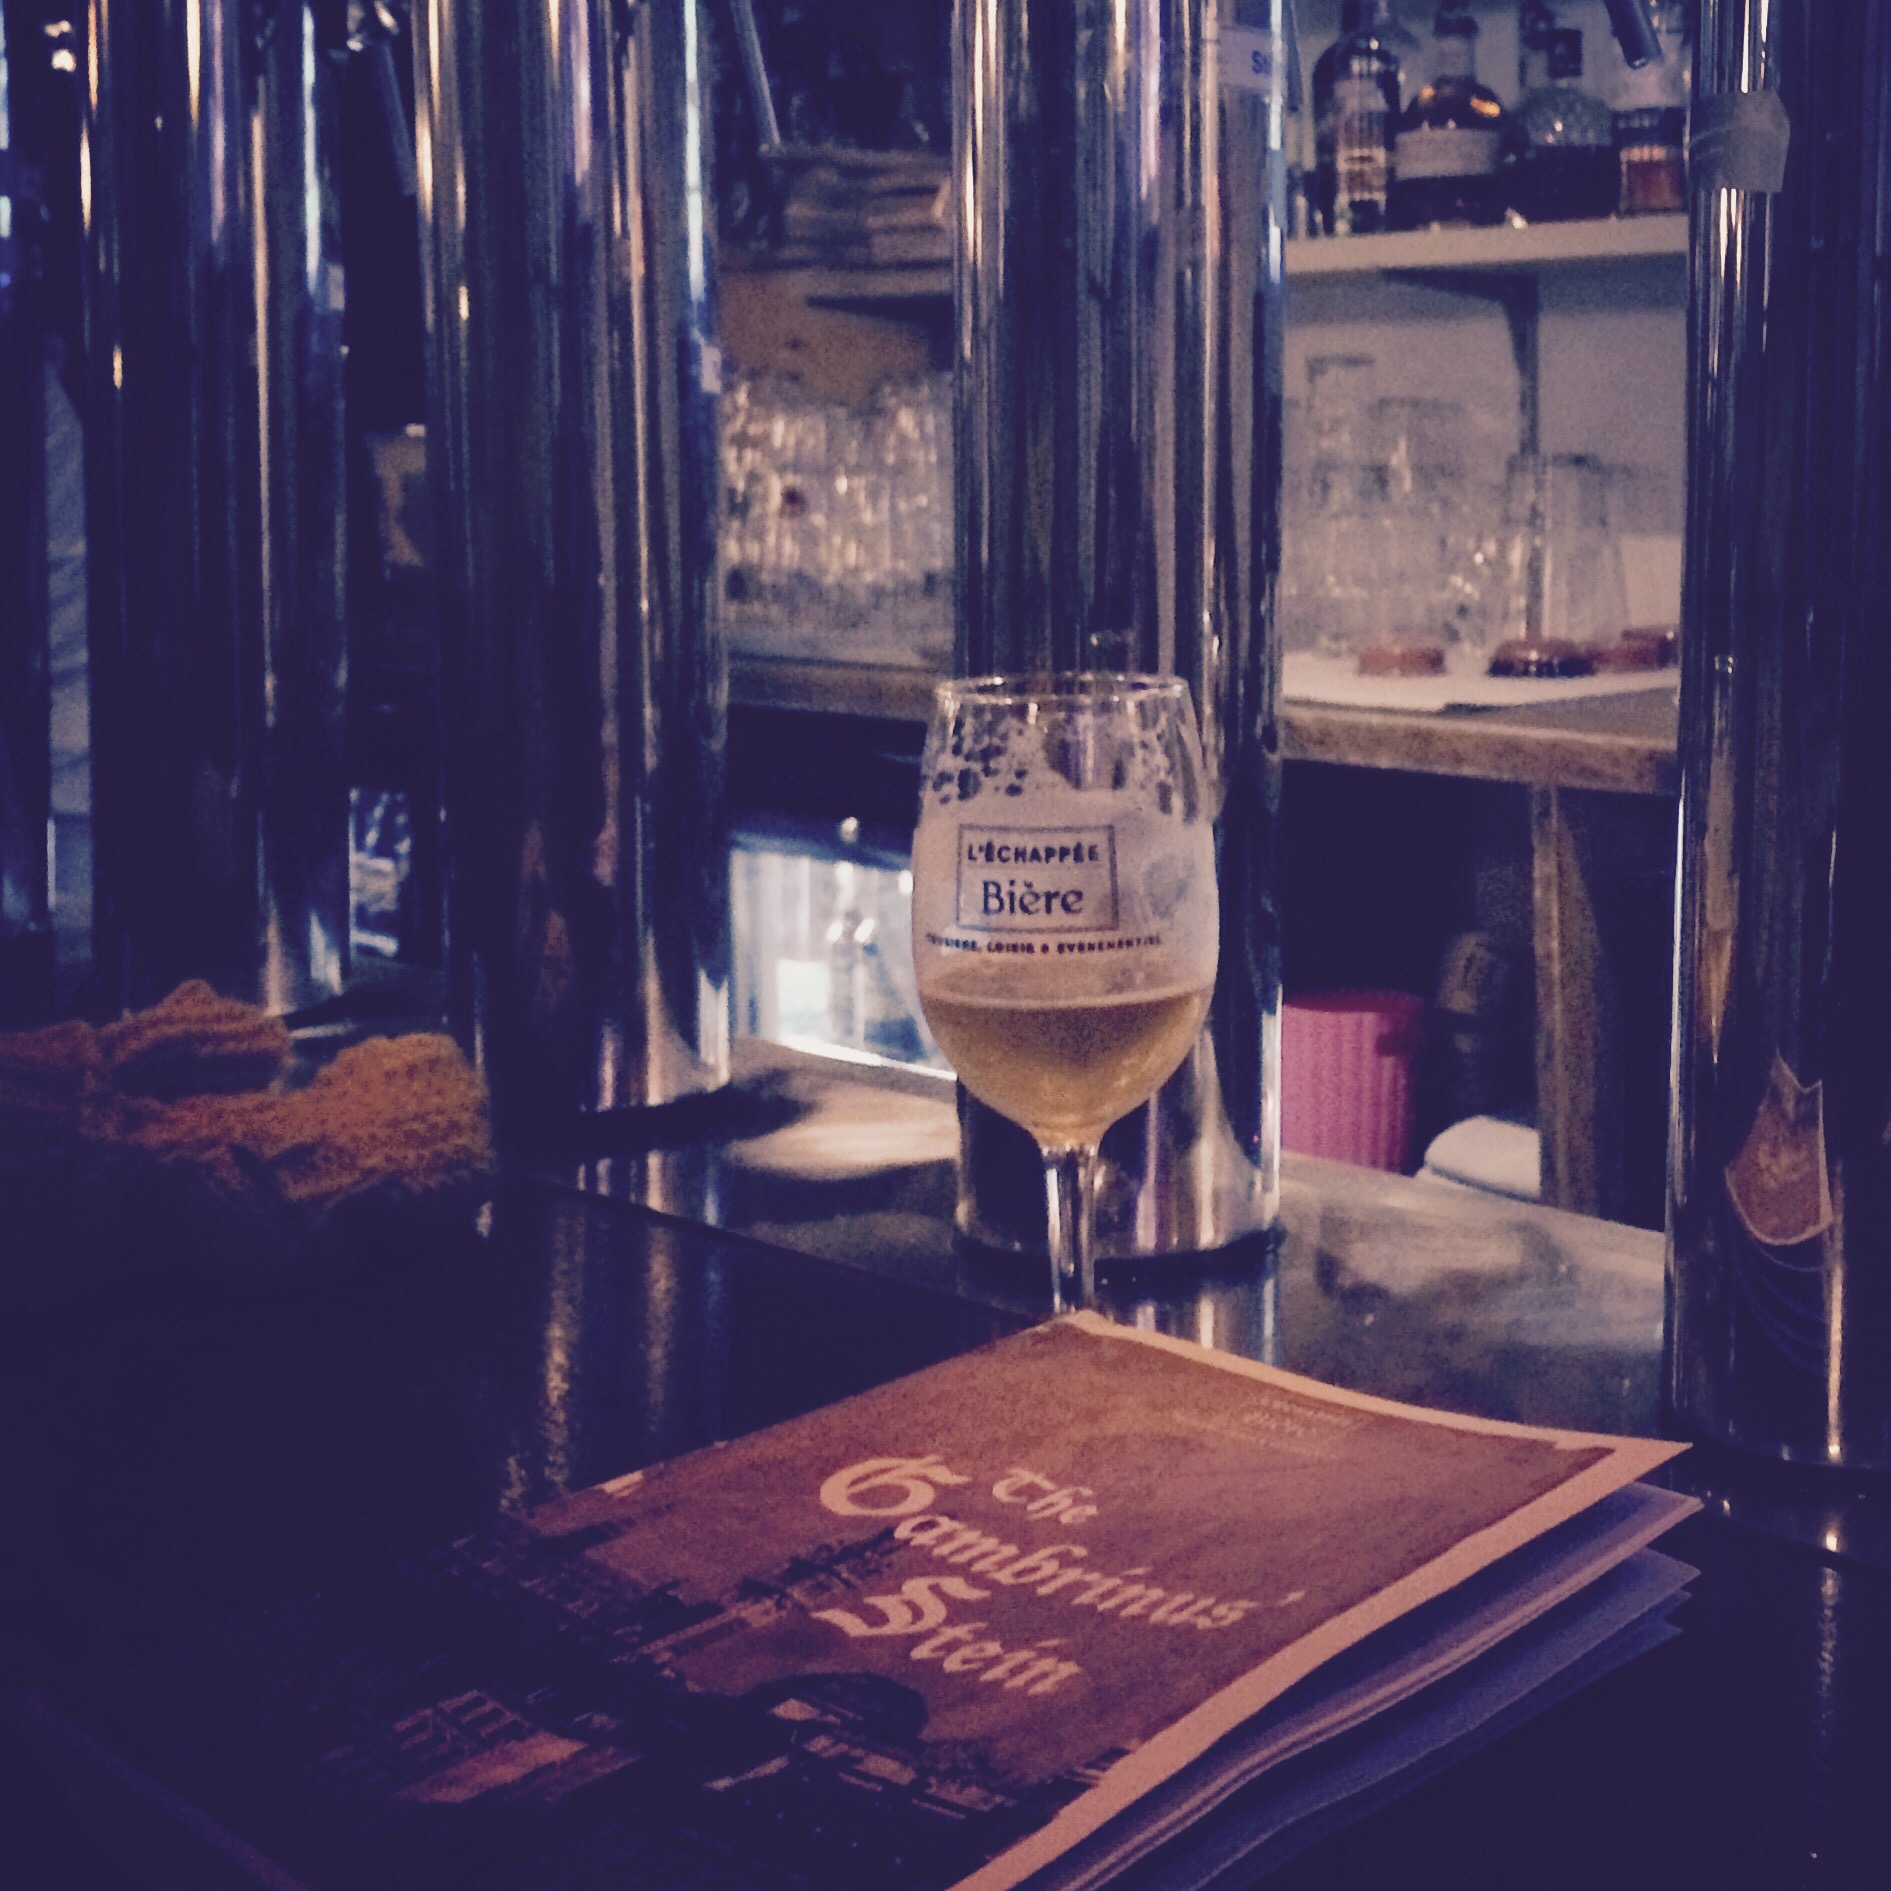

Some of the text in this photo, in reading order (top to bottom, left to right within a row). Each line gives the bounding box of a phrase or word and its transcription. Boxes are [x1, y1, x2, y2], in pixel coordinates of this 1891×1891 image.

[967, 841, 1099, 864] L'ÉCHAPPÉE
[982, 879, 1084, 915] Bière
[991, 1466, 1098, 1525] The
[810, 1576, 1082, 1697] Stein
